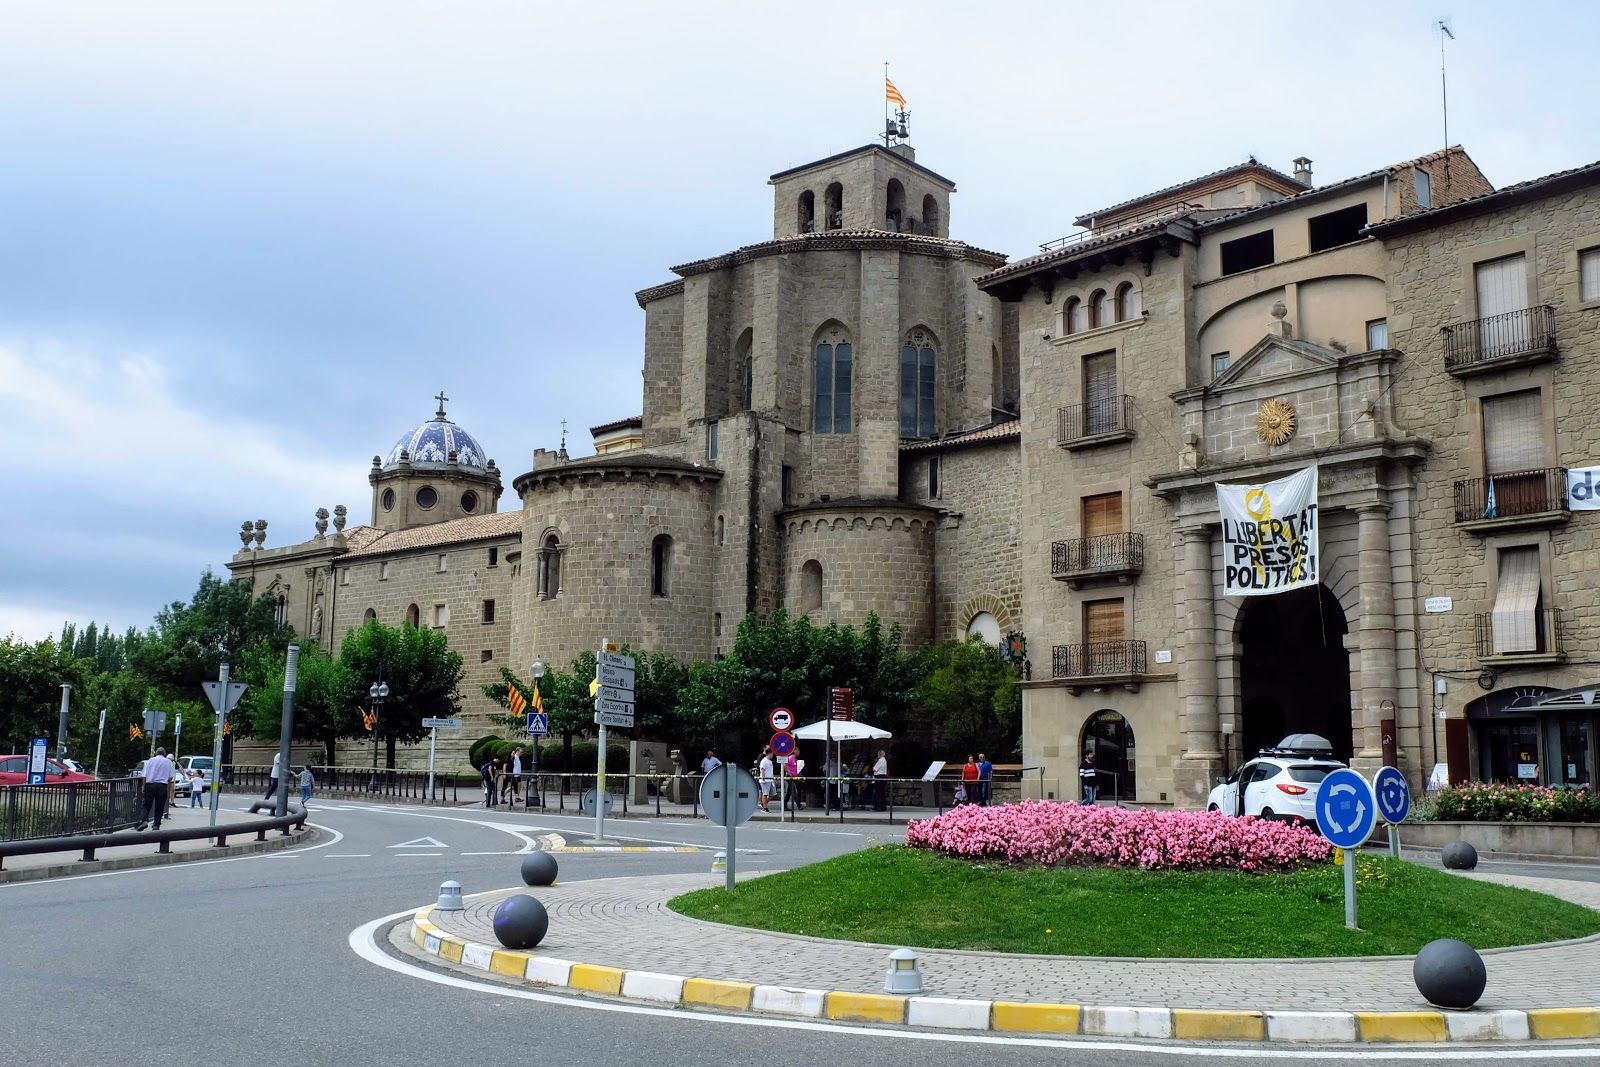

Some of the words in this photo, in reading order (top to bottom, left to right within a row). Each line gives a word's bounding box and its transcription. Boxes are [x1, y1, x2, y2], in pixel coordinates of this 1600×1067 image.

[1571, 471, 1600, 501] d
[1223, 503, 1317, 547] LLIBERTAT
[1233, 535, 1309, 566] PRESOS
